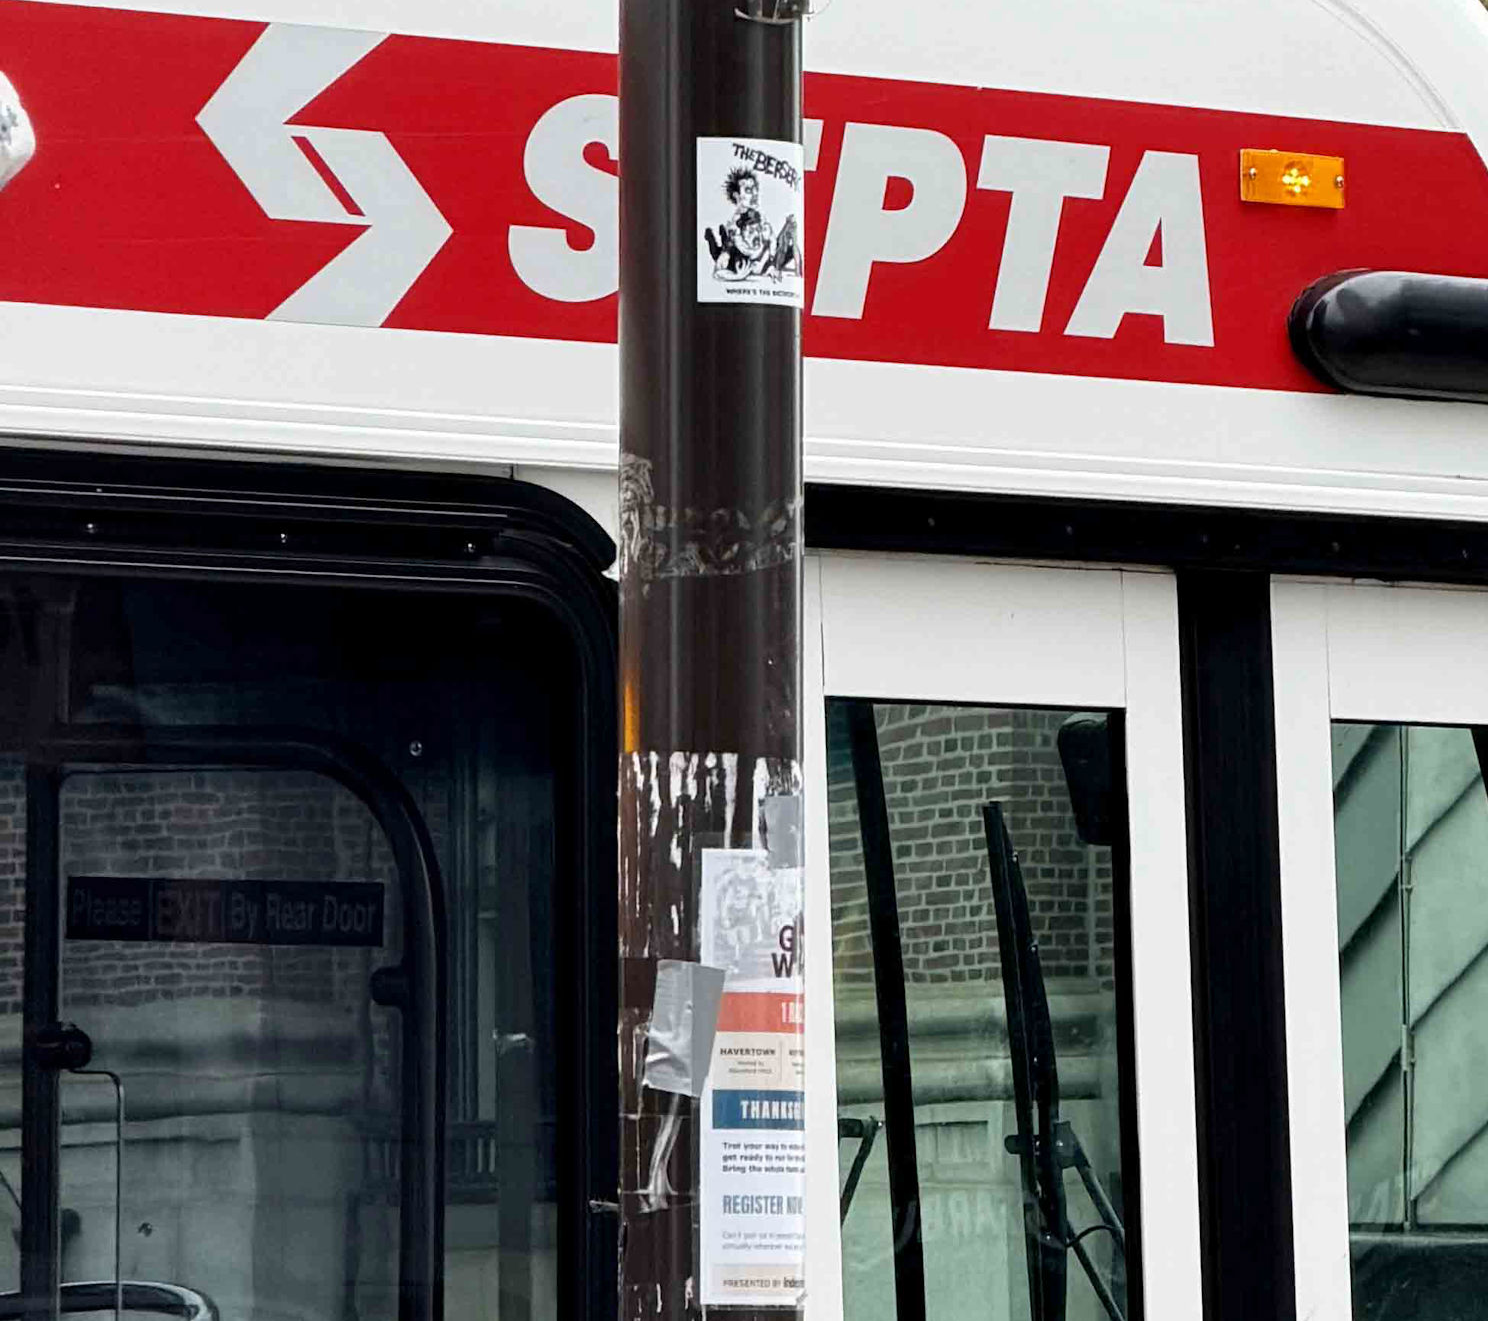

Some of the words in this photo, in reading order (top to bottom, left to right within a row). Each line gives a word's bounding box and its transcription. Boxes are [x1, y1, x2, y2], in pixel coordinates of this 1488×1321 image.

[733, 143, 755, 161] THE
[753, 150, 801, 189] BERSER
[507, 93, 1215, 347] SPTA
[72, 887, 142, 928] Please
[157, 888, 221, 936] EXIT
[232, 892, 258, 936] By
[266, 893, 315, 932] Rear
[323, 895, 375, 934] Door
[720, 1048, 776, 1056] HAVERTOWN
[740, 1100, 802, 1120] THANKSG
[723, 1195, 783, 1215] REGISTER
[723, 1279, 771, 1288] PRESENTED
